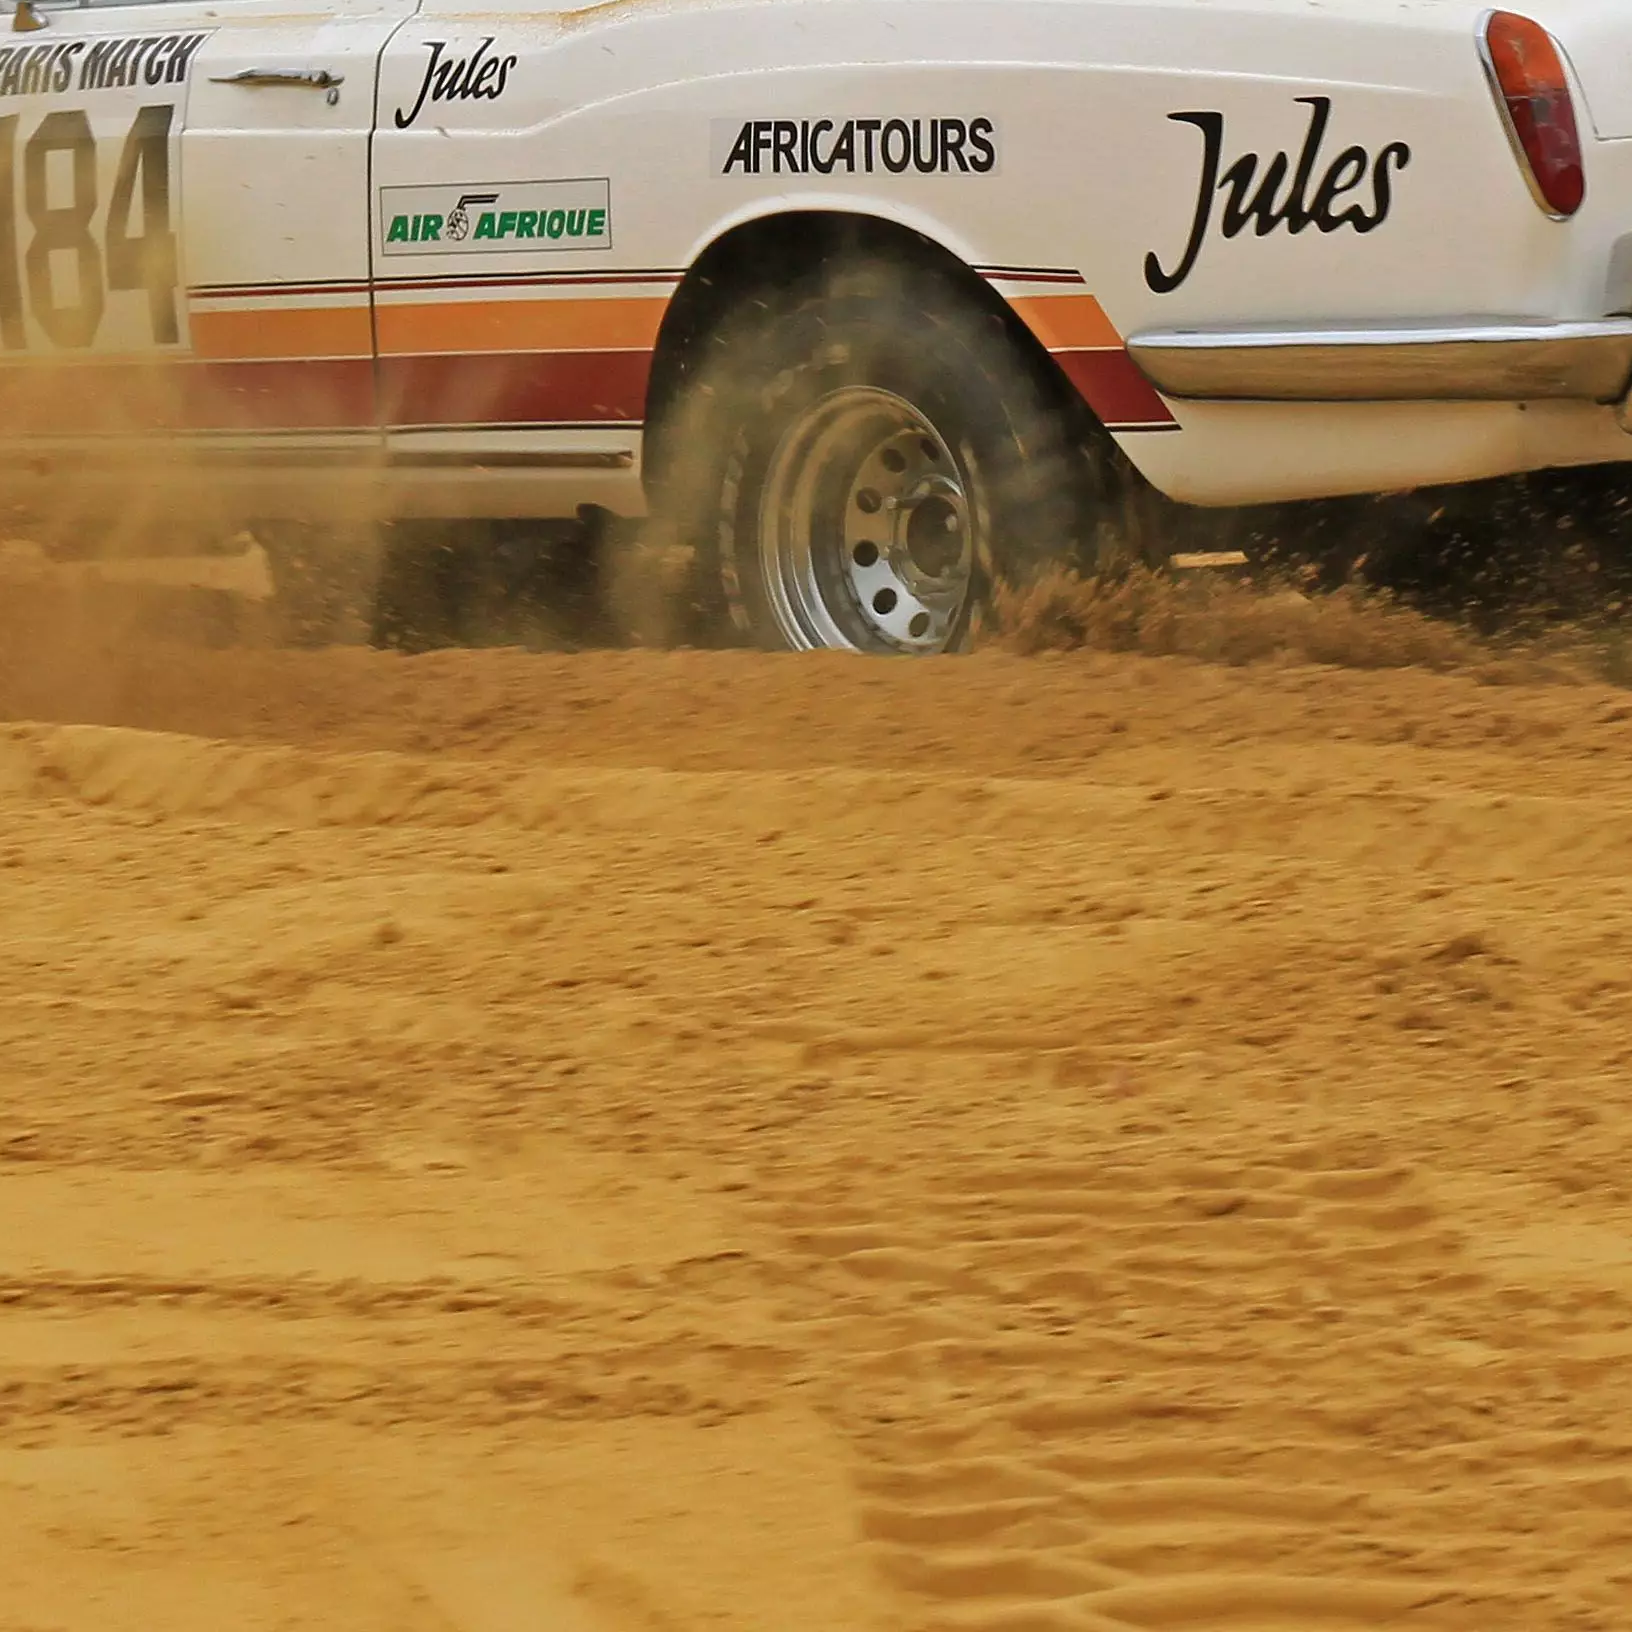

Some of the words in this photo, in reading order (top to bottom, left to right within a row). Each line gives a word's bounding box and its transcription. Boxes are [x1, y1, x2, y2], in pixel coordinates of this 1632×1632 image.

[78, 33, 208, 91] MATCH
[394, 36, 518, 129] Jules
[722, 117, 995, 174] AFRICATOURS
[1143, 96, 1411, 294] Jules
[386, 212, 443, 243] AIR
[472, 207, 607, 241] AFRIQUE
